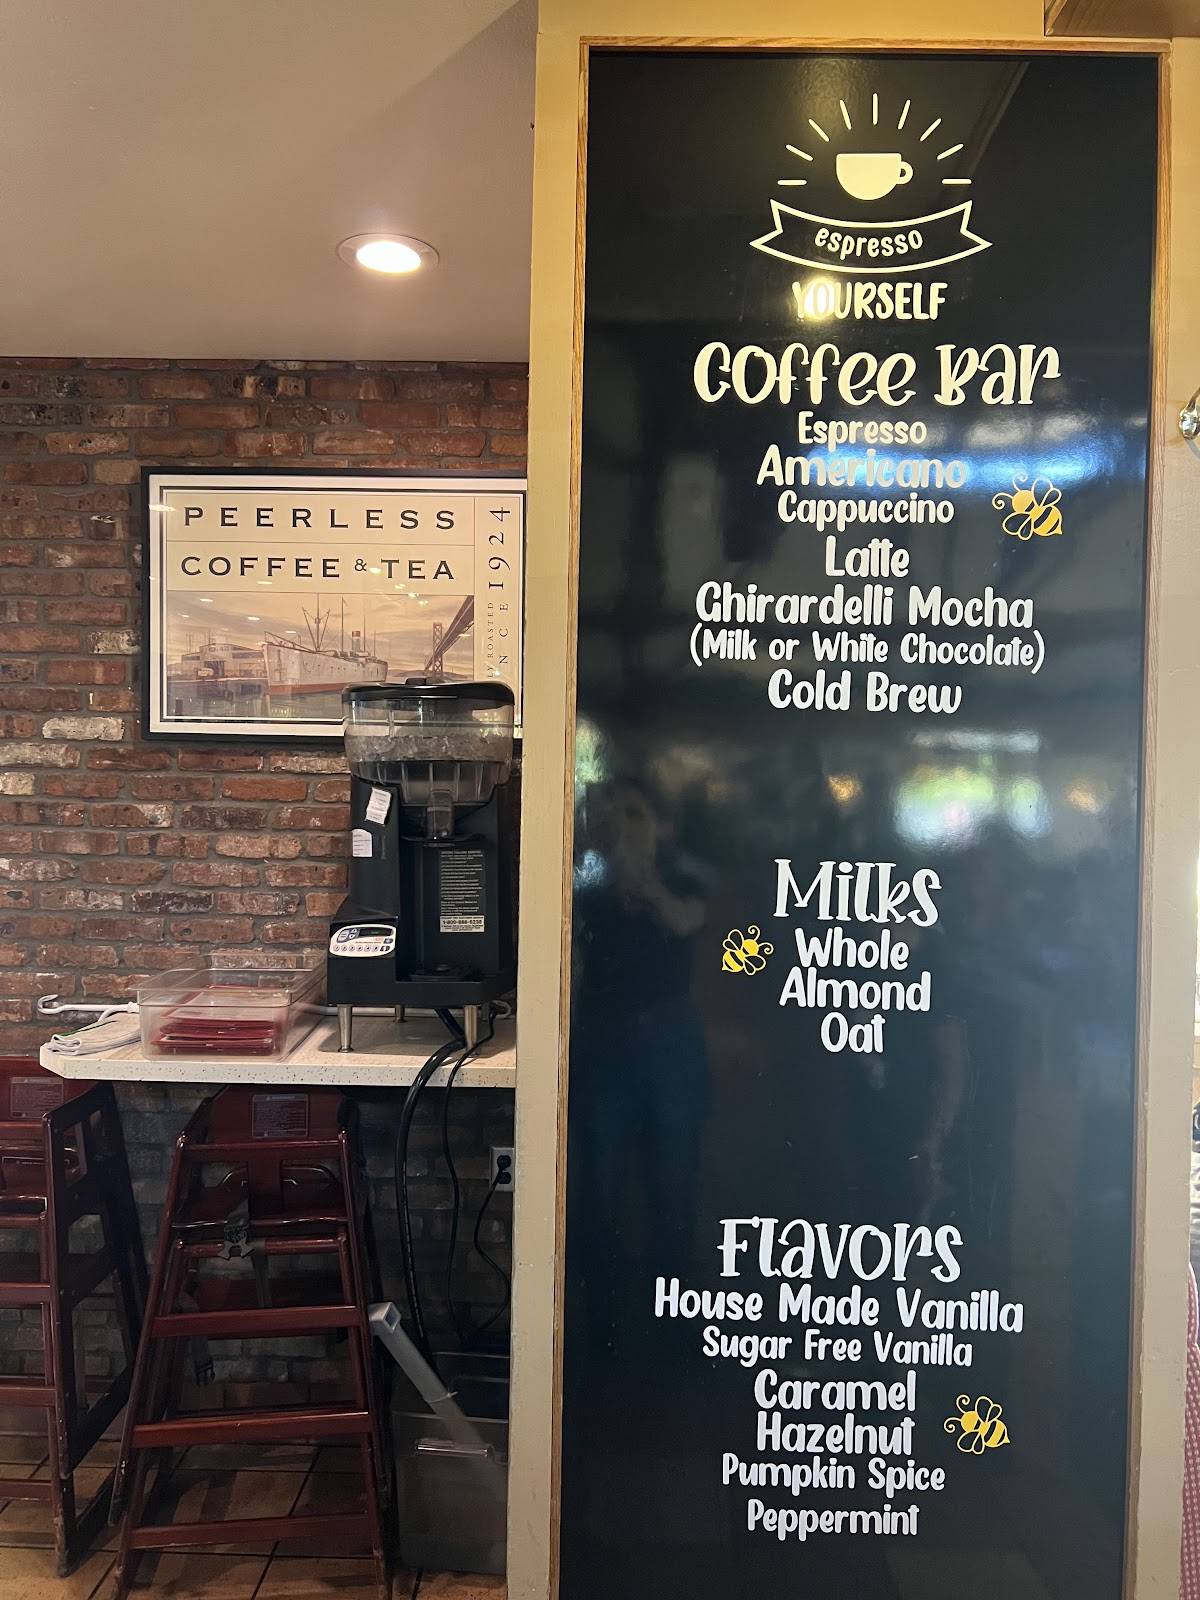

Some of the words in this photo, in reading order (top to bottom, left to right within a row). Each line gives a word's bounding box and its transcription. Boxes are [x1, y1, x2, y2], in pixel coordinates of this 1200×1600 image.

[814, 226, 923, 260] espresso
[792, 281, 948, 320] YOURSELF
[693, 341, 917, 407] Coffee
[933, 343, 1061, 405] Bar
[798, 411, 926, 448] Espresso
[756, 444, 966, 487] Americano
[184, 507, 454, 529] PEERLESS
[777, 490, 954, 530] Cappuccino
[181, 556, 339, 577] COFFEE
[354, 558, 366, 571] &
[381, 559, 453, 579] TEA
[488, 506, 511, 590] 1924
[825, 535, 909, 577] Latte
[695, 581, 893, 625] Ghirardelli
[909, 585, 1033, 628] Mocha
[486, 601, 495, 660] ROASTED
[498, 602, 509, 665] NCE
[690, 623, 756, 666] (Milk
[768, 638, 799, 660] or
[812, 631, 888, 662] White
[900, 632, 1045, 674] Chocolate)
[768, 668, 850, 710] Cold
[866, 672, 962, 713] Brew
[773, 858, 941, 926] Milks
[794, 926, 908, 969] Whole
[779, 966, 930, 1011] Almond
[821, 1011, 884, 1053] Oat
[716, 1216, 963, 1282] Flavors
[654, 1277, 762, 1321] House
[778, 1282, 878, 1325] Made
[896, 1287, 1023, 1332] Vanilla
[702, 1325, 791, 1367] Sugar
[804, 1329, 861, 1360] Free
[873, 1330, 972, 1366] Vanilla
[753, 1368, 916, 1410] Caramel
[756, 1410, 914, 1455] Hazelnut
[721, 1452, 855, 1495] Pumpkin
[867, 1457, 945, 1497] Spice
[747, 1498, 919, 1540] Peppermint
